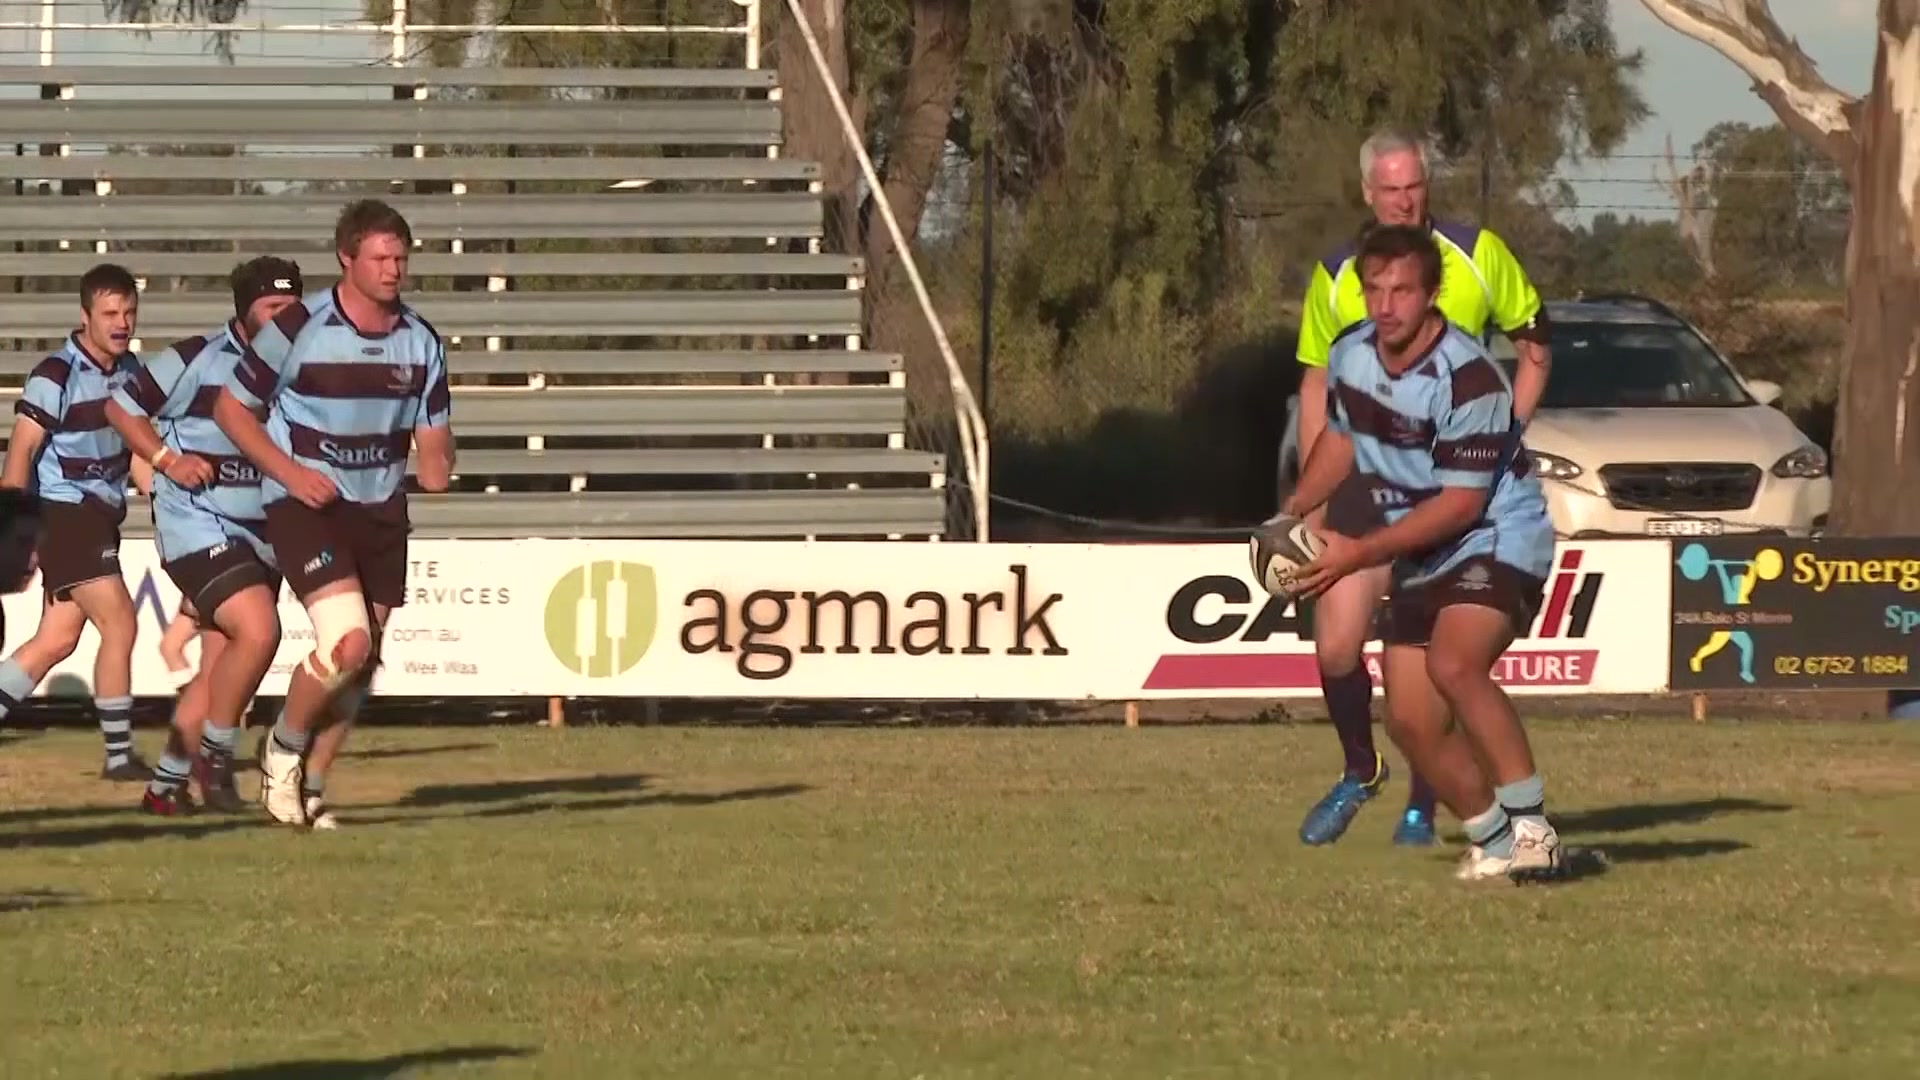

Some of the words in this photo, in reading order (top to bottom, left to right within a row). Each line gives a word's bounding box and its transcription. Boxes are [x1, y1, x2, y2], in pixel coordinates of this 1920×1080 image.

[319, 440, 389, 463] Santo
[1792, 552, 1920, 592] Synerg
[403, 587, 511, 605] ERVICES
[1165, 575, 1316, 643] CA
[680, 564, 1068, 680] agmark
[1774, 656, 1801, 674] 02
[1804, 656, 1855, 674] 6752
[1861, 655, 1908, 674] 1884
